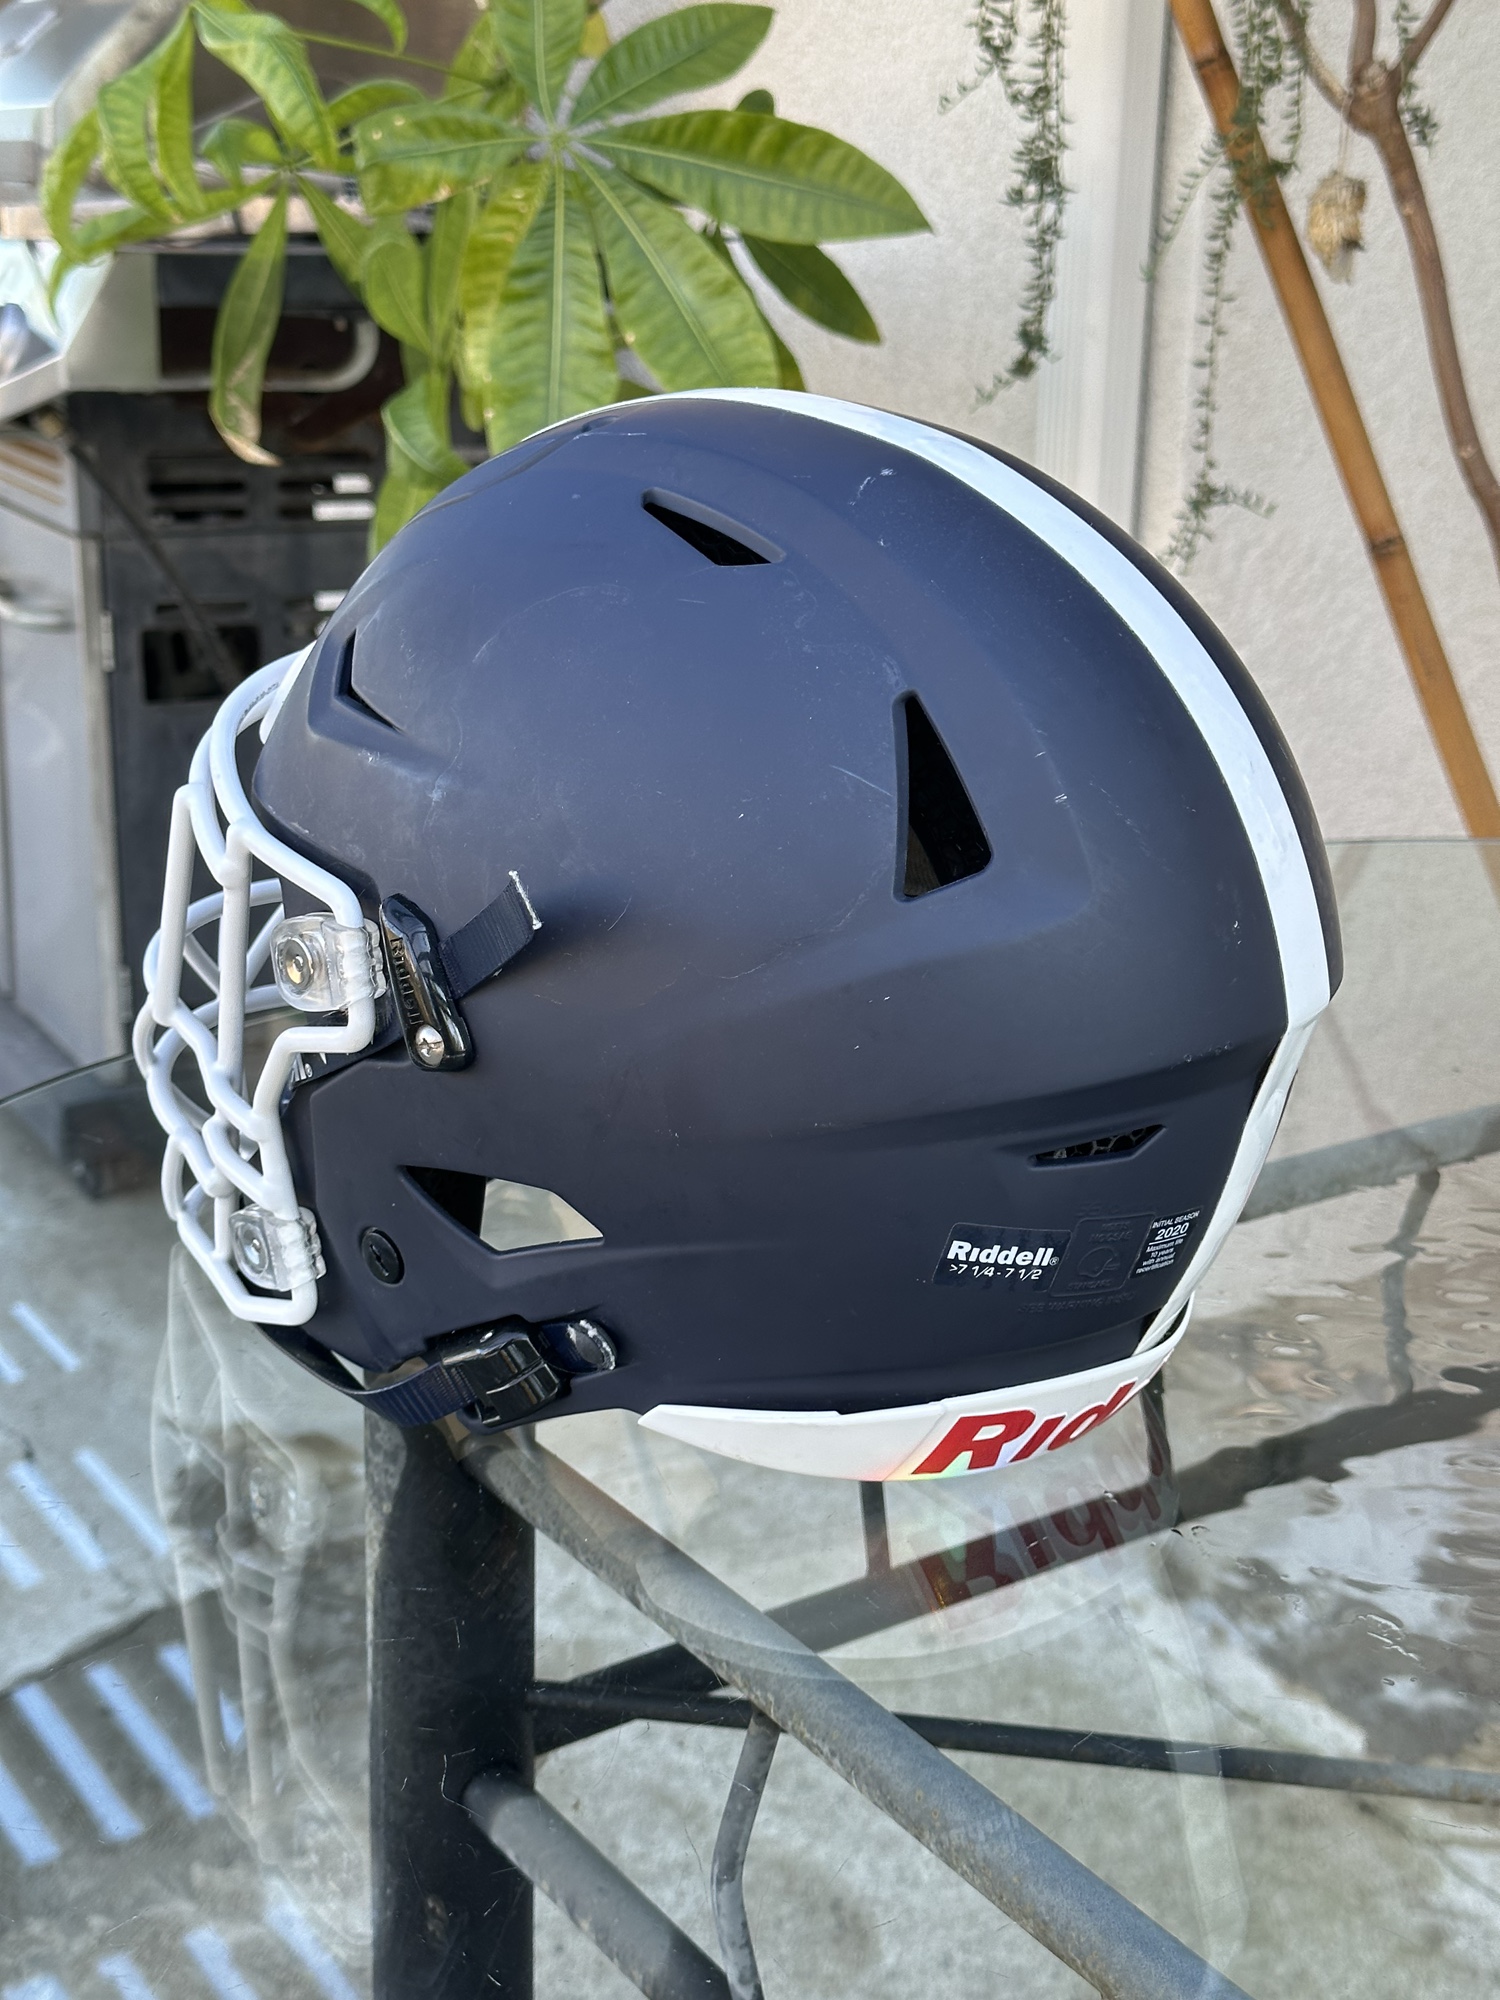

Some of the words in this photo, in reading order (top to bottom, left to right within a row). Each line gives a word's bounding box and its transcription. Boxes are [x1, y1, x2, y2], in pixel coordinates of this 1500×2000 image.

[1152, 1218, 1174, 1229] INITIAL
[1174, 1210, 1200, 1224] SEASON
[1154, 1222, 1190, 1241] 2020
[1145, 1241, 1175, 1253] Maximum
[949, 1263, 968, 1275] >7
[971, 1265, 995, 1278] 1/4
[1004, 1267, 1016, 1278] 7
[1018, 1268, 1043, 1281] 1/2
